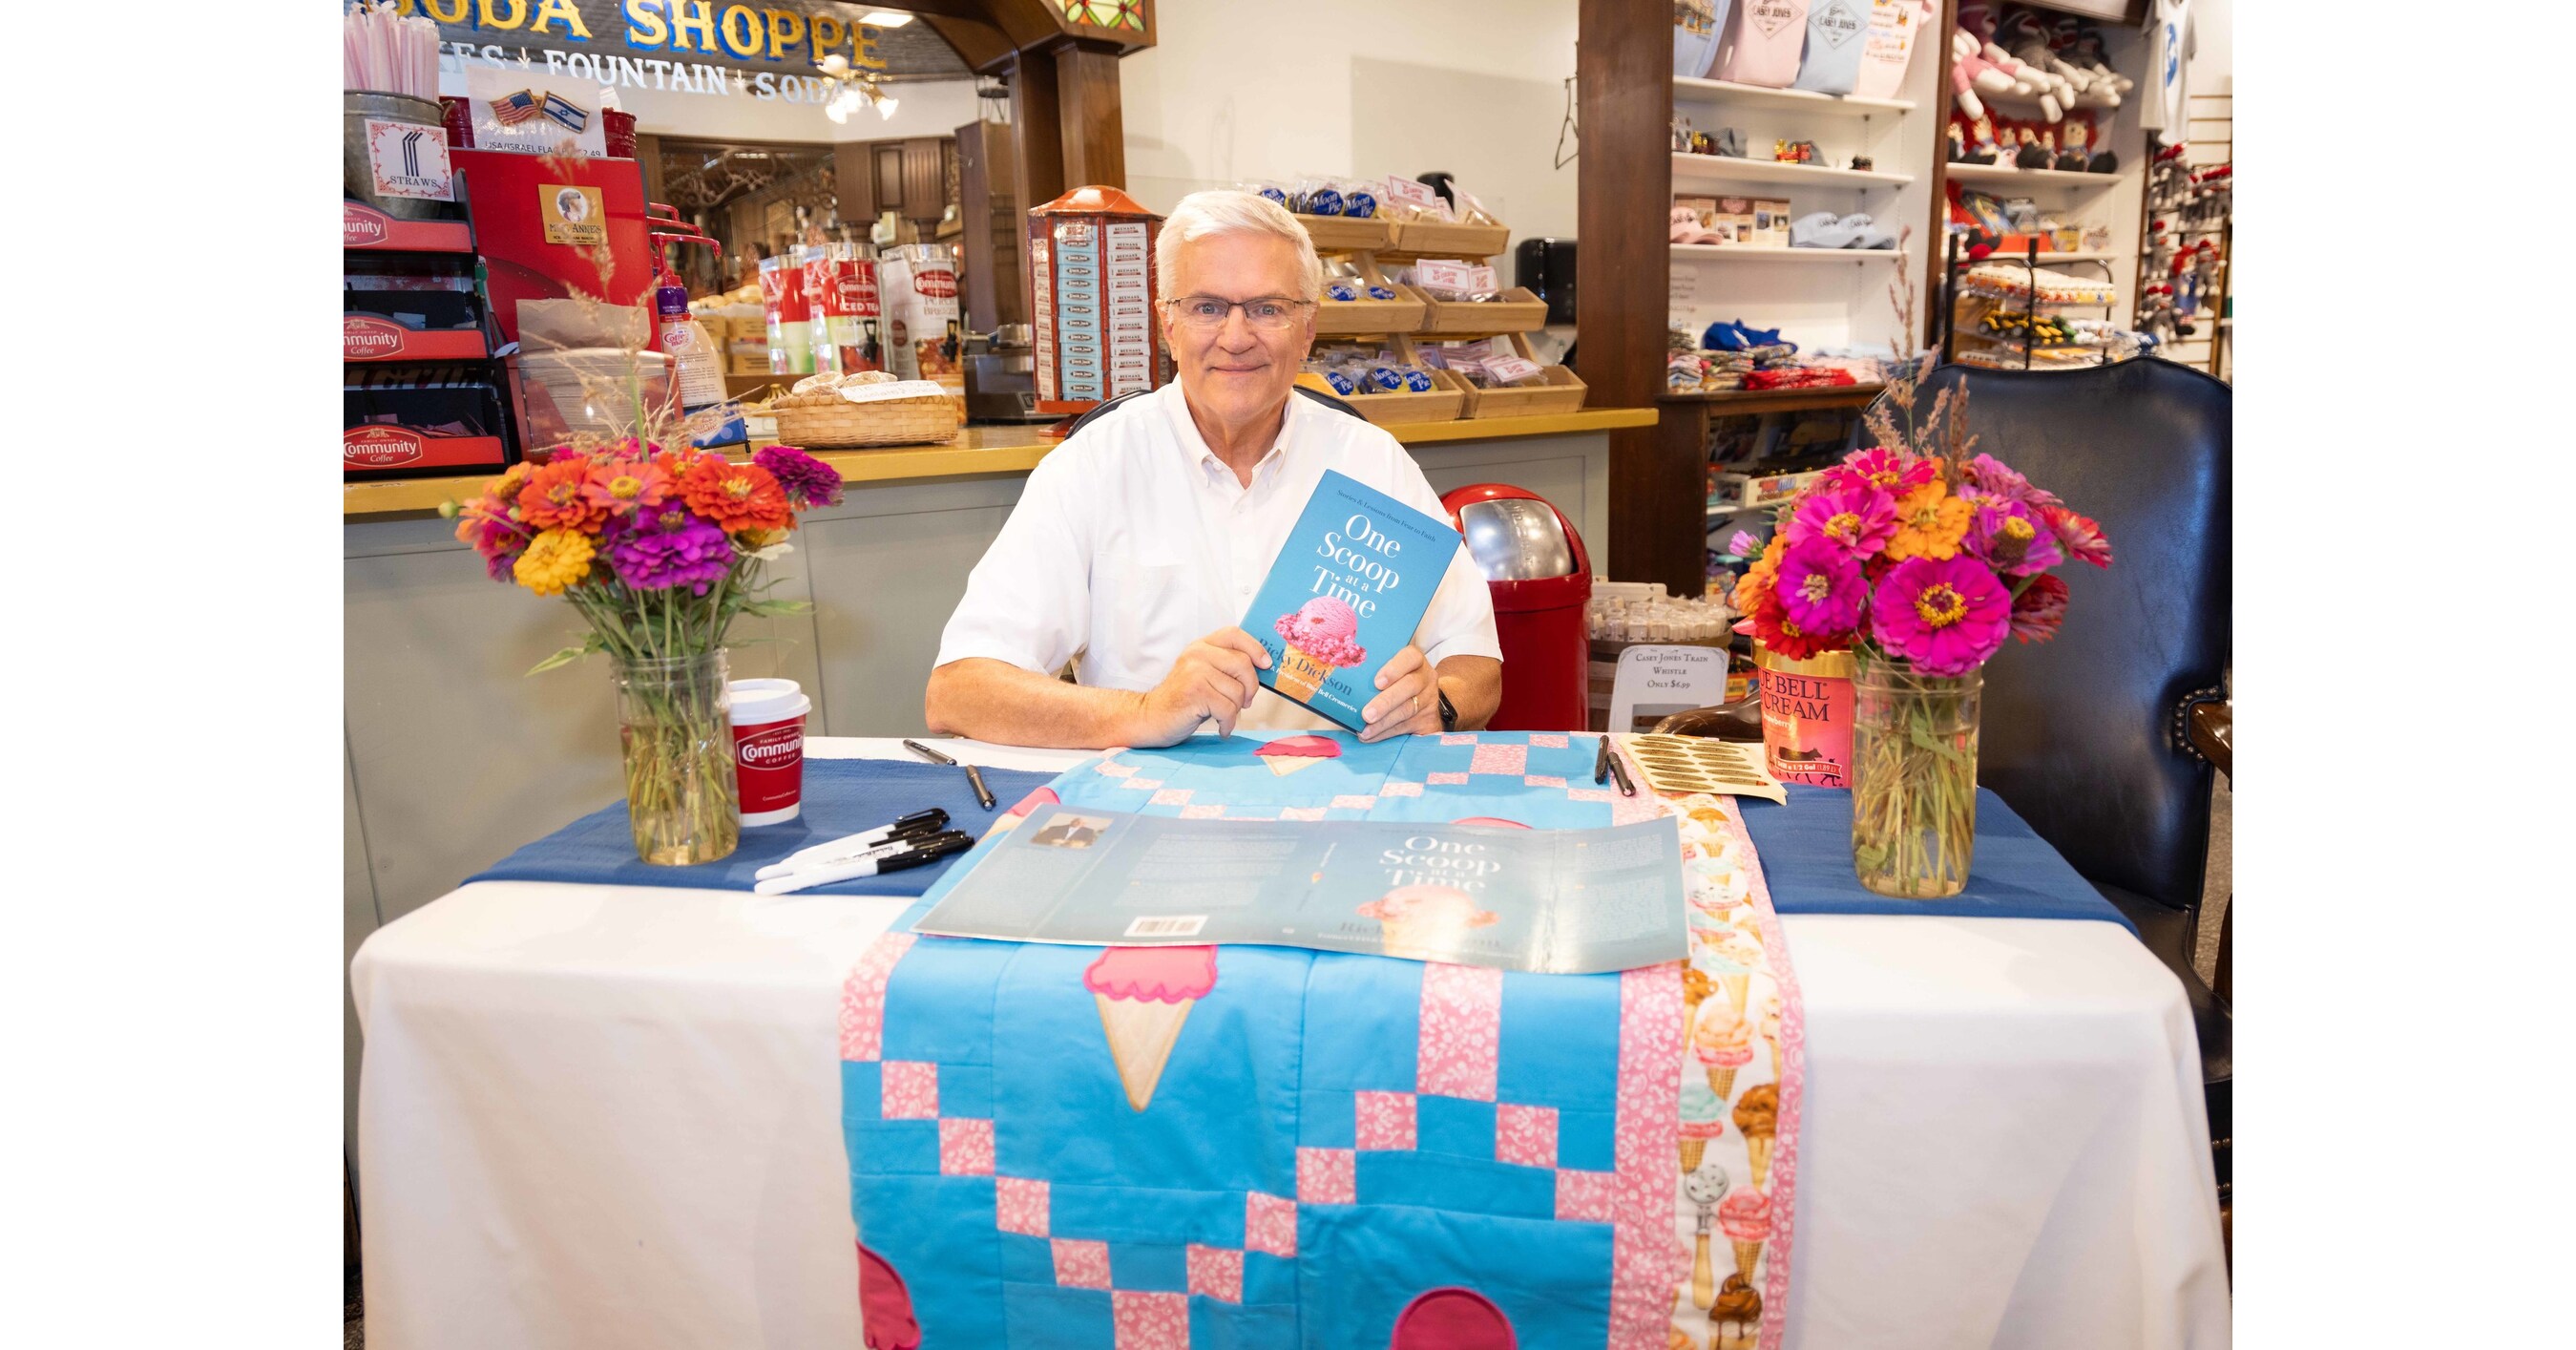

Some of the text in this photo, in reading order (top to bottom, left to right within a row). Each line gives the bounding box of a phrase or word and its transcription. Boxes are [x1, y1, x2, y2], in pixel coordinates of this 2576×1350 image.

[623, 0, 888, 70] SHOPPE
[542, 49, 729, 95] FOUNTAIN
[389, 175, 437, 189] STRAWS
[1346, 196, 1371, 211] Moon
[840, 302, 865, 312] ICED
[350, 346, 375, 355] Coffee
[344, 440, 417, 458] Community
[369, 454, 394, 464] Coffee
[1337, 489, 1357, 503] Stories
[1363, 500, 1387, 517] Lessons
[1346, 514, 1401, 559] One
[1316, 532, 1400, 595] Scoop
[1309, 564, 1376, 619] Time
[1346, 574, 1369, 591] at a
[1636, 653, 1709, 664] CASEY JONES TRAIN
[1296, 657, 1352, 696] Dickson
[1653, 666, 1688, 676] WHISTLE
[1317, 687, 1329, 699] Bell
[1647, 681, 1691, 690] ONLY $6.99
[1776, 674, 1830, 700] BELL
[1765, 692, 1830, 722] CREAM
[760, 736, 781, 745] FAMILY
[765, 752, 796, 765] COFFEE
[1405, 836, 1486, 854] One
[1379, 849, 1501, 876] Scoop
[1385, 867, 1486, 894] Time
